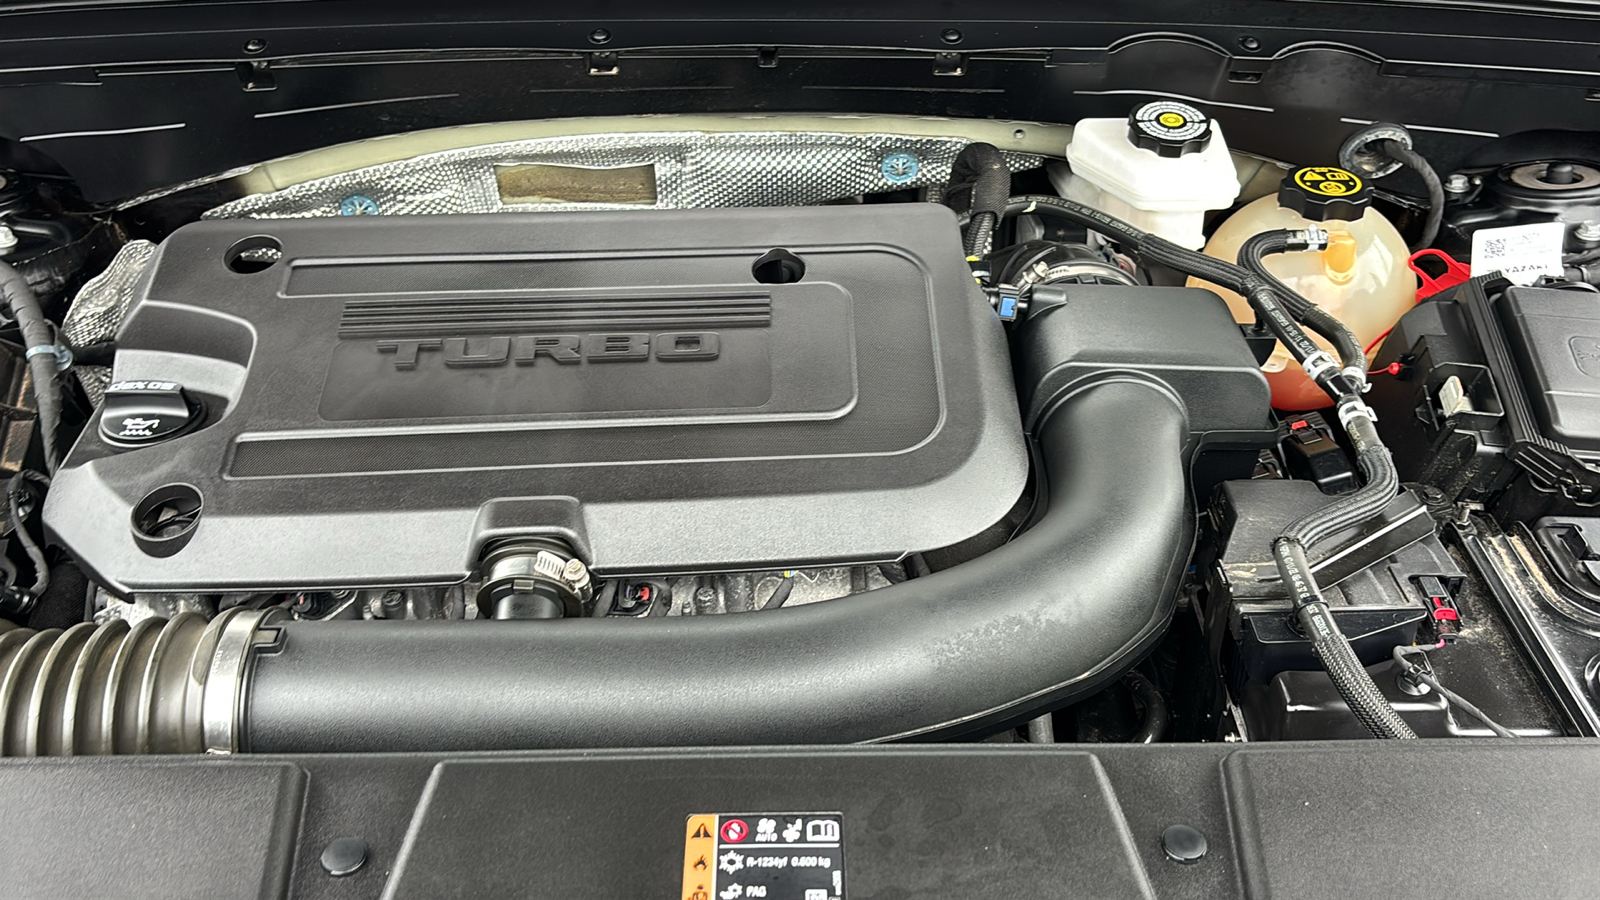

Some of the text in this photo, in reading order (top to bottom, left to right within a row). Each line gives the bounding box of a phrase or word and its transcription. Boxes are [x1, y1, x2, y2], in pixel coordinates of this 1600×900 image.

[1504, 264, 1548, 274] YAZAKI
[376, 331, 721, 370] TURBO
[755, 833, 778, 842] AUTO
[746, 856, 831, 869] R-1234yf 0.600 kg
[745, 885, 767, 898] PAG
